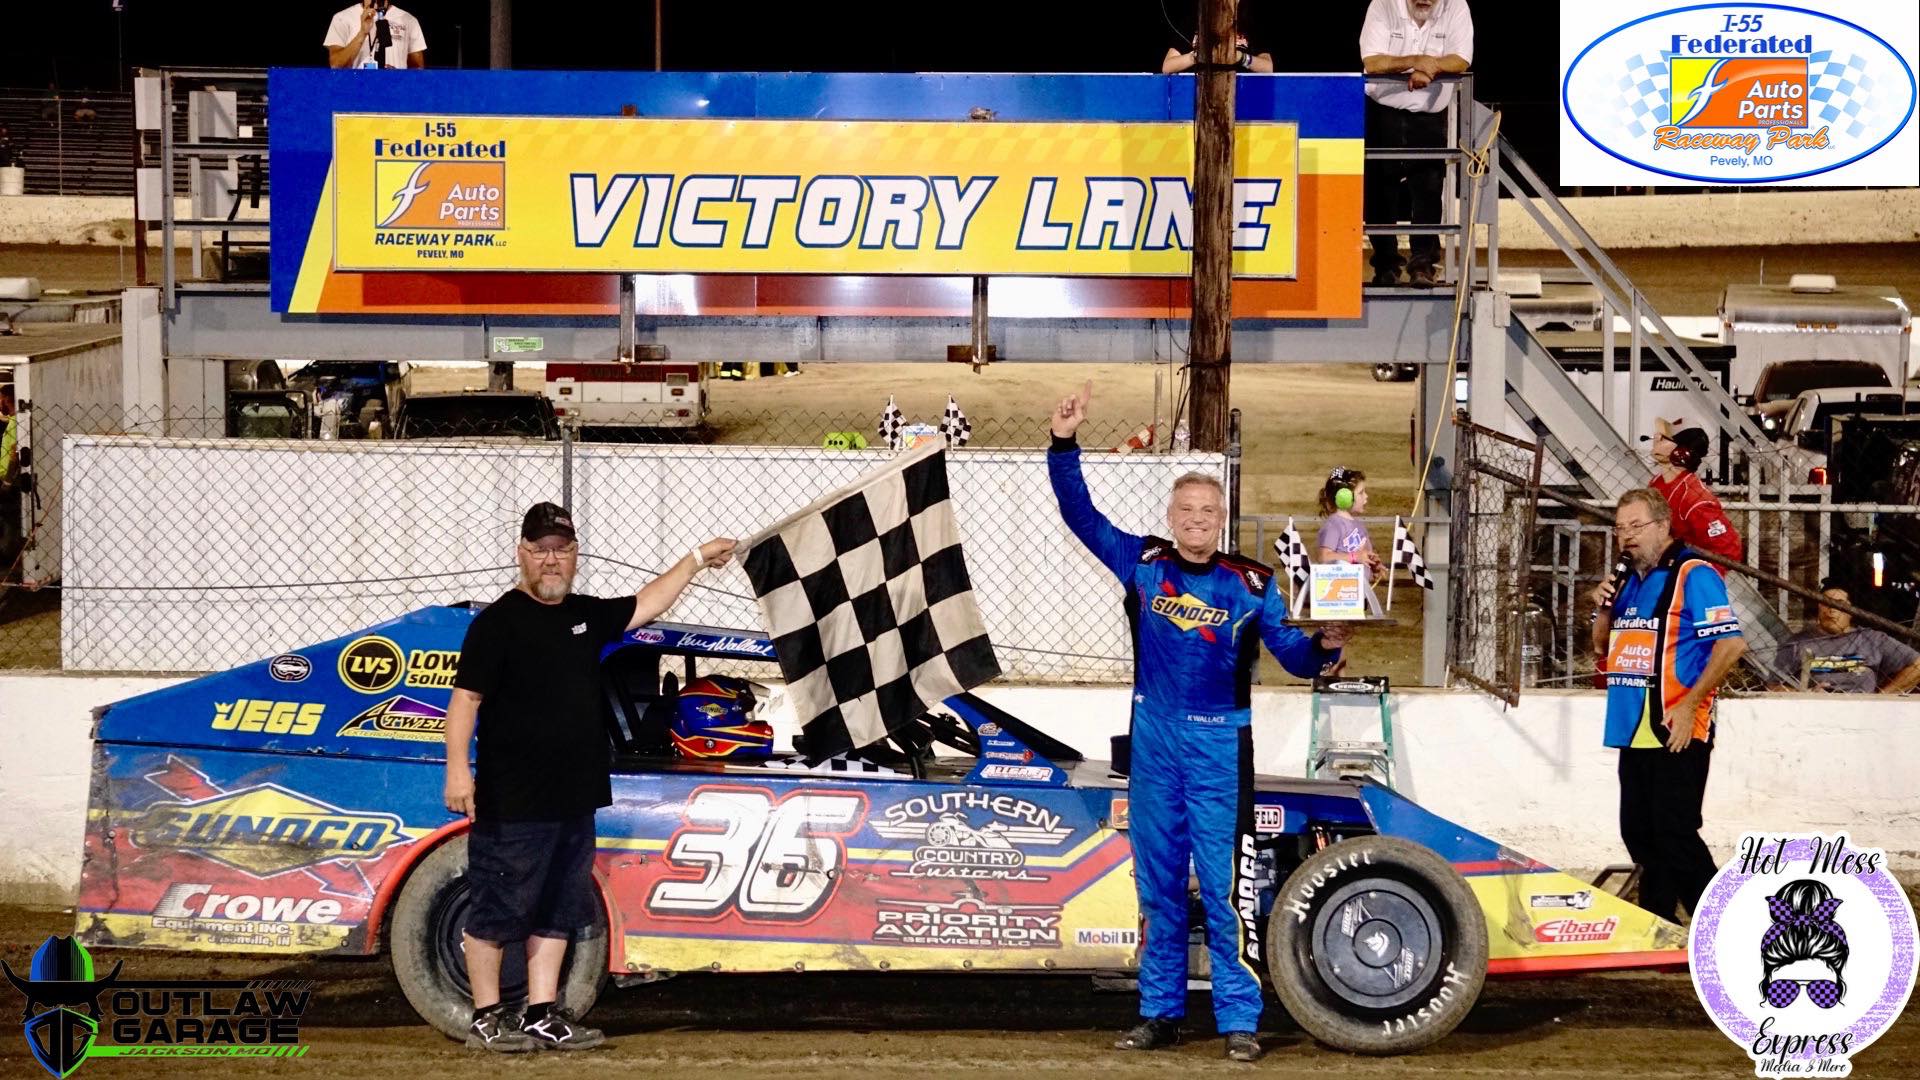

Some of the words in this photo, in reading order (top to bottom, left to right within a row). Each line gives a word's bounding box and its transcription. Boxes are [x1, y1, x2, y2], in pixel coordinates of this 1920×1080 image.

[425, 122, 457, 137] I-55
[375, 139, 506, 158] Federated
[447, 183, 500, 201] Auto
[440, 202, 500, 221] Parts
[570, 173, 998, 250] VICTORY
[1015, 176, 1282, 251] LANE
[375, 233, 450, 246] RACEWAY
[453, 234, 496, 247] PARK
[417, 249, 448, 259] PEVELY,
[450, 249, 464, 258] MO
[1153, 598, 1226, 625] SUNOCO
[1622, 645, 1651, 657] Auto
[350, 656, 394, 675] LVS
[1615, 657, 1650, 669] Parts
[1622, 677, 1648, 688] PARK
[212, 699, 326, 736] JEGS
[1194, 715, 1225, 723] WALLACE
[885, 791, 1061, 832] SOUTHERN
[149, 811, 388, 851] SUNOCO
[644, 785, 869, 924] 36
[923, 850, 1017, 865] COUNTRY
[909, 860, 1030, 879] Customs
[1283, 848, 1375, 924] Hoosier
[152, 882, 343, 923] Crowe
[1238, 833, 1261, 962] SUNOCO
[258, 923, 294, 935] INC.
[878, 911, 1058, 928] PRIORITY
[874, 924, 1057, 940] AVIATION
[1078, 931, 1119, 944] Mobil
[1121, 931, 1135, 944] 1
[1534, 917, 1617, 942] Eibach
[902, 936, 992, 945] SERVICES
[998, 939, 1031, 947] LLC
[1383, 962, 1470, 1037] Hoosier
